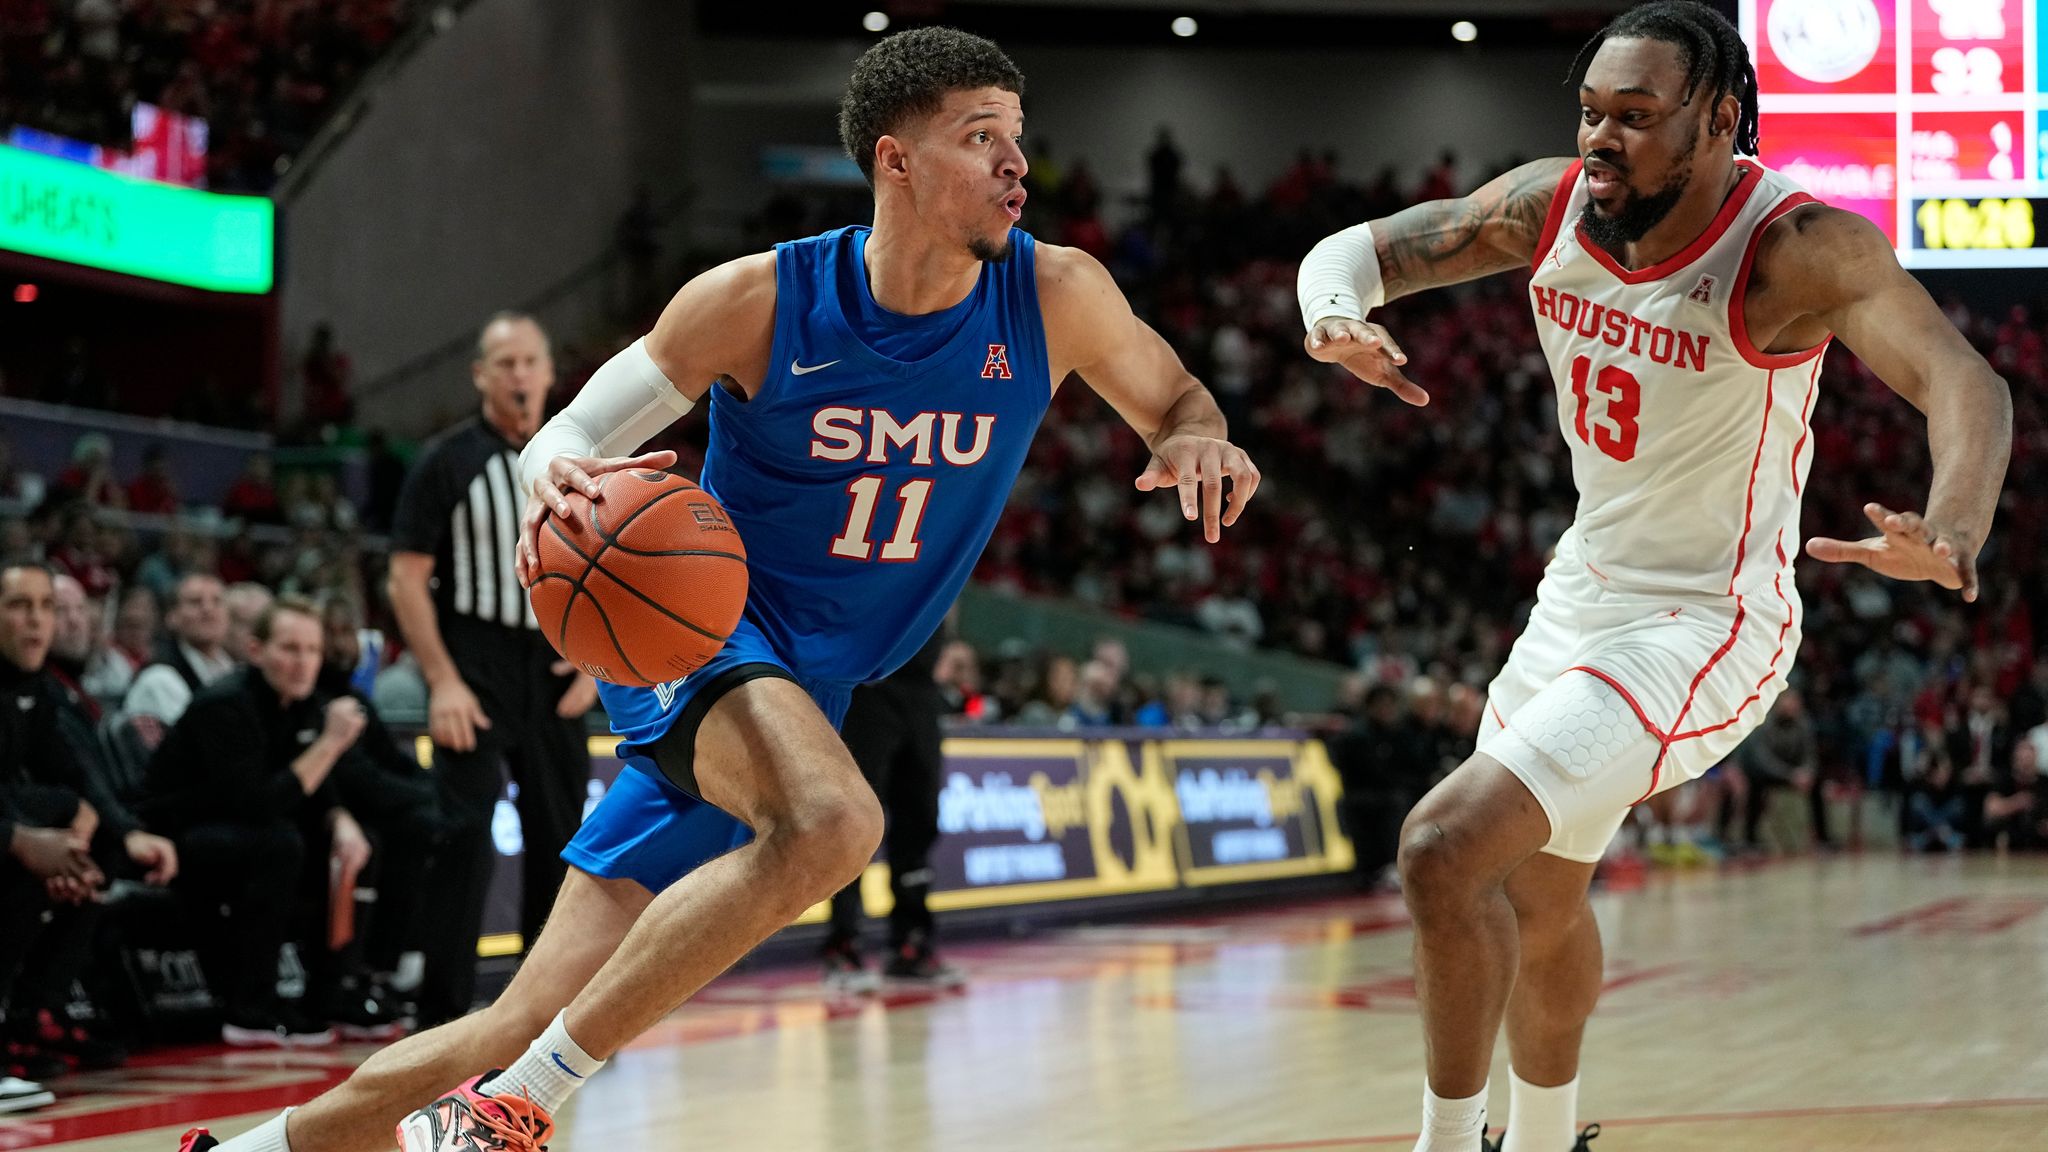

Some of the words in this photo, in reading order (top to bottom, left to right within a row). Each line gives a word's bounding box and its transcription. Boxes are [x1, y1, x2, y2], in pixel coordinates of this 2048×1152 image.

[1687, 274, 1717, 306] A
[980, 343, 1012, 379] A
[1532, 285, 1710, 372] HOUSTON
[810, 406, 997, 466] SMU
[1571, 354, 1641, 463] 13
[829, 474, 935, 562] 11
